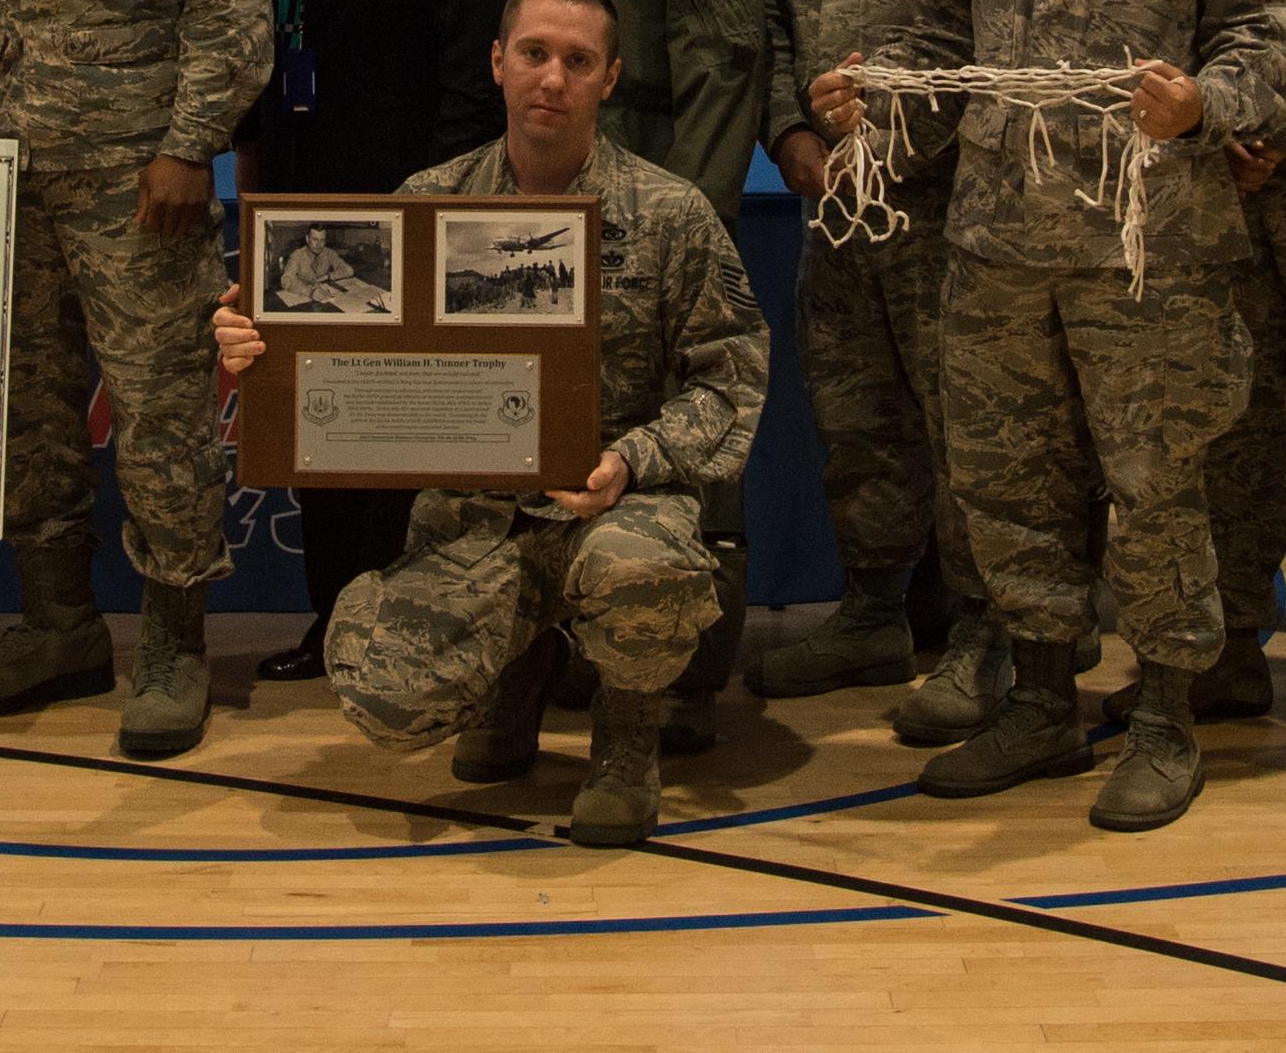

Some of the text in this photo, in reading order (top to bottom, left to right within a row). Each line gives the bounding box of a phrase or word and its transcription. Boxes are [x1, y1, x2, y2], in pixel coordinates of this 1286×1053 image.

[615, 276, 653, 290] FORCE
[331, 358, 349, 367] The
[363, 358, 381, 367] Gen
[383, 358, 421, 367] William
[473, 359, 506, 370] Trophy
